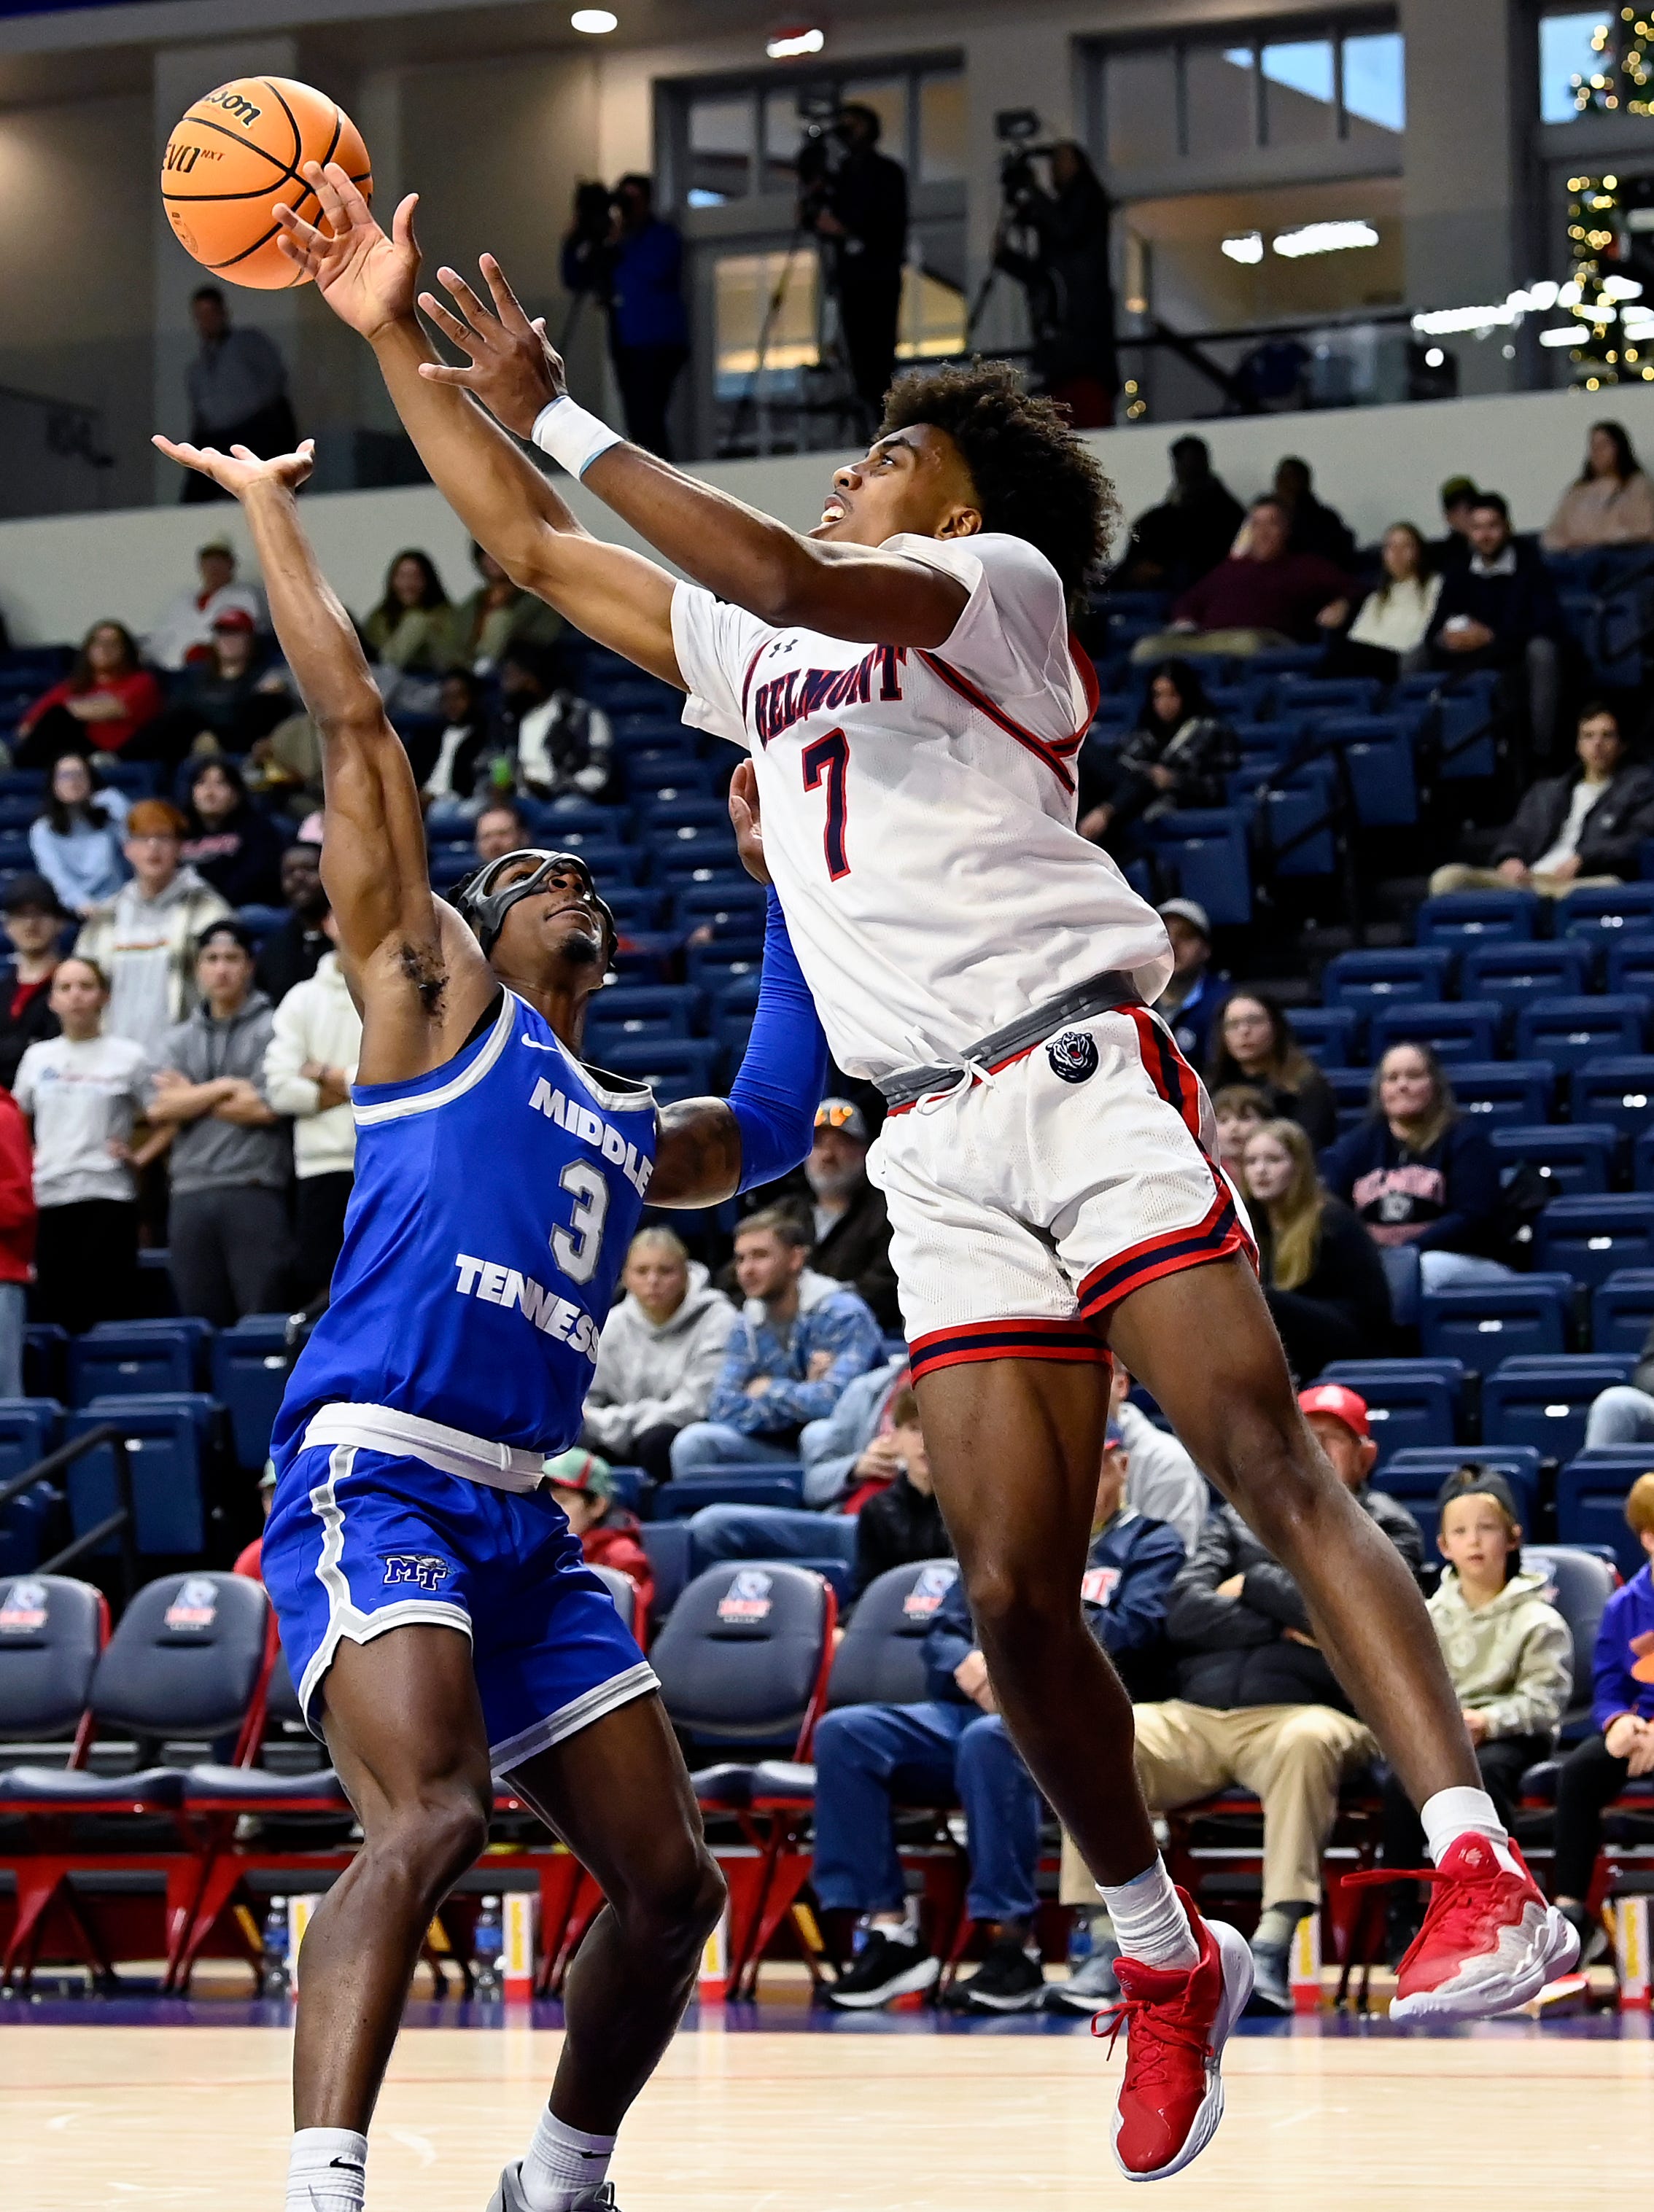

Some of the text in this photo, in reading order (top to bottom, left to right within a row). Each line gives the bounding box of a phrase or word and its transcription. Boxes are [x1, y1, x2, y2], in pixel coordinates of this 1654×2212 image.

[201, 149, 226, 161] NXT
[756, 643, 907, 752] BELMONT
[801, 727, 851, 882] 7
[528, 1076, 654, 1198] MIDDLE
[549, 1158, 610, 1285] 3
[384, 1557, 449, 1592] MT
